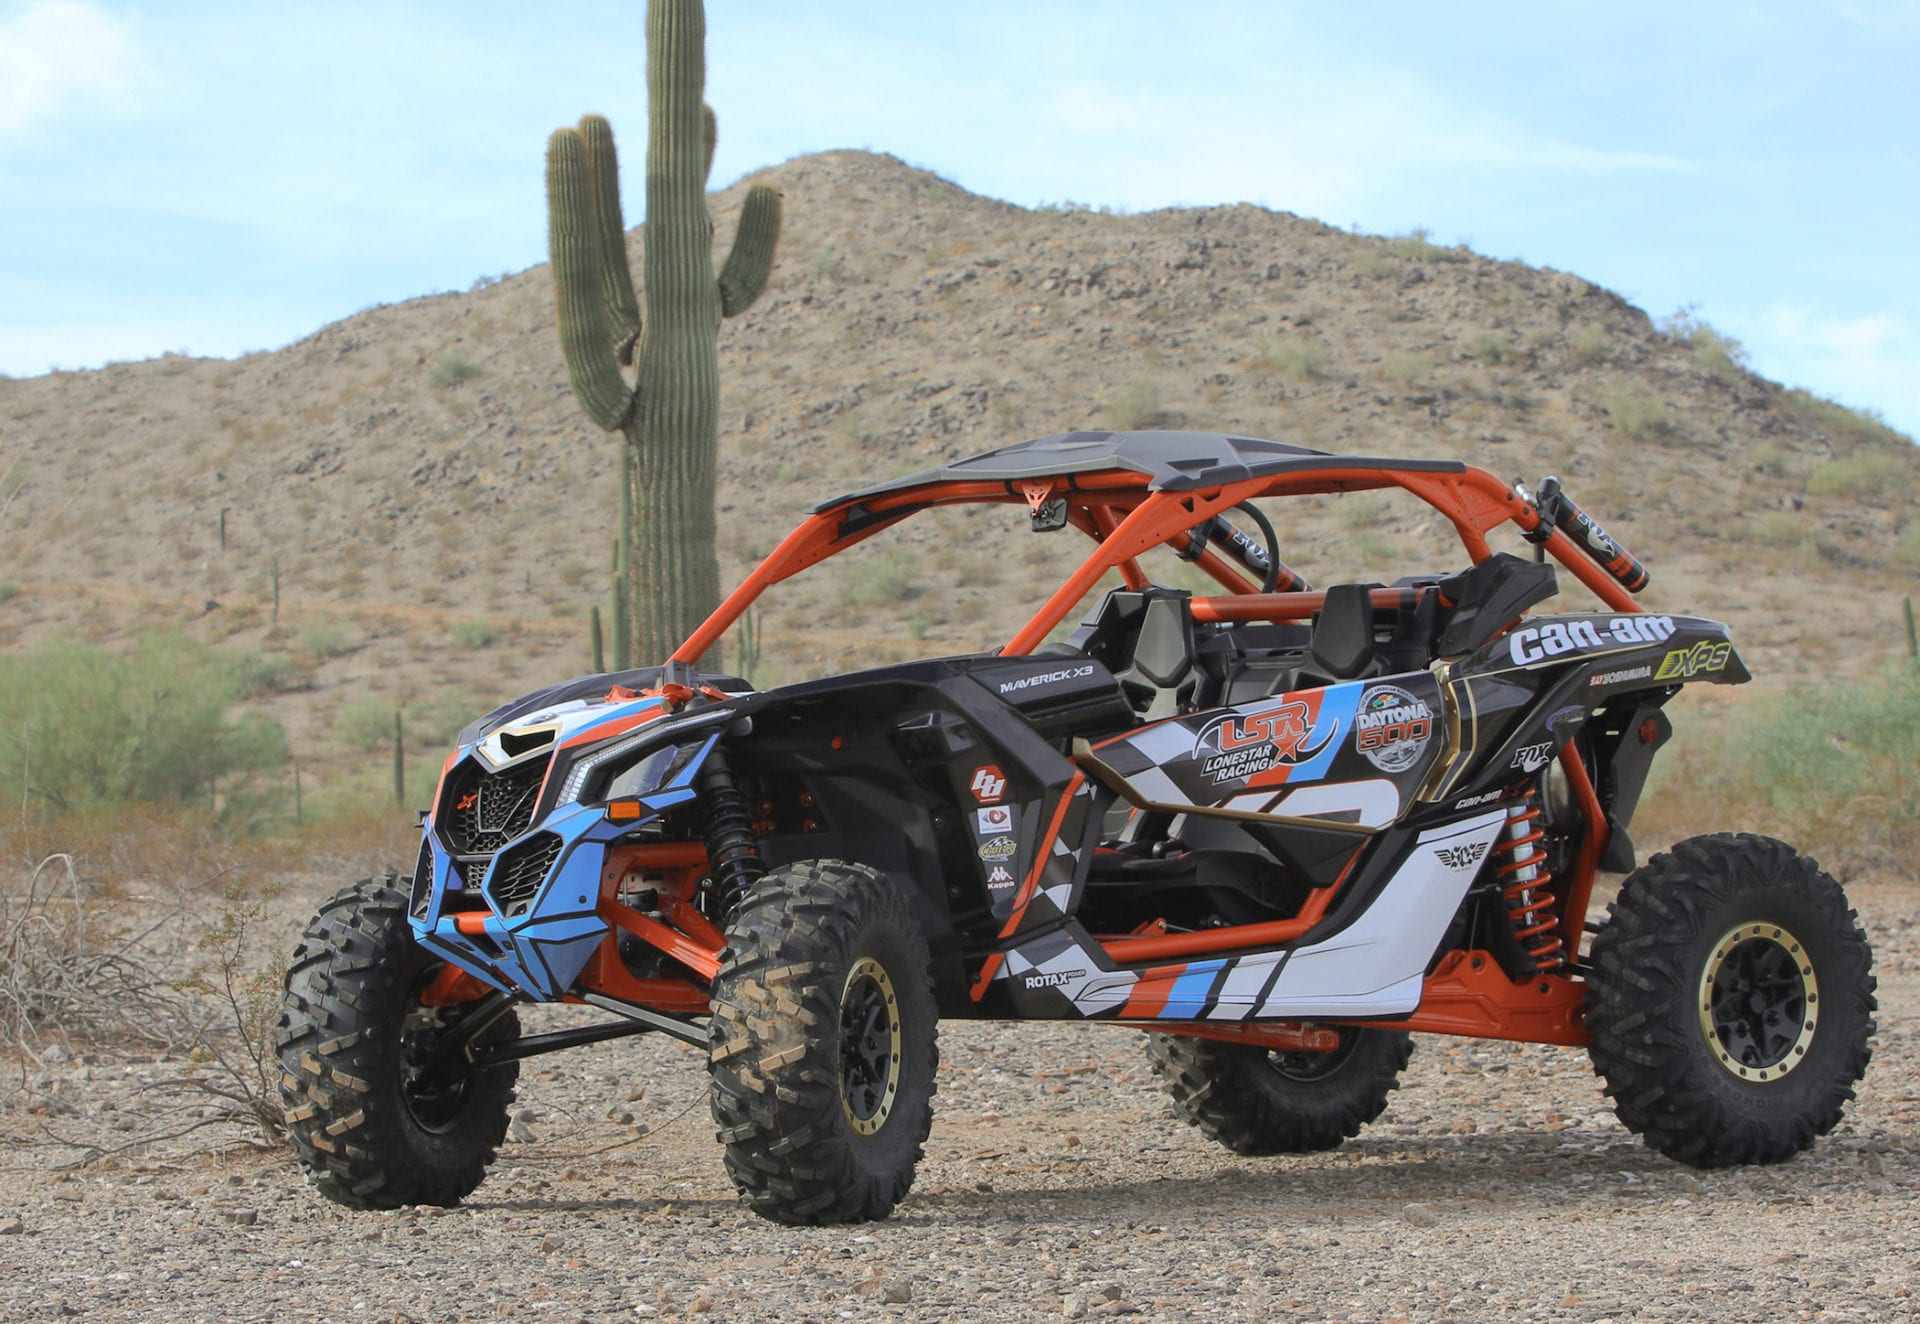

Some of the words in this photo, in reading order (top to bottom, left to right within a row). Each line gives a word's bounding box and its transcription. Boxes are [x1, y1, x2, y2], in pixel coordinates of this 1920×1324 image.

[1673, 640, 1732, 677] XPS
[1000, 671, 1071, 693] MAVERICK
[1073, 666, 1093, 678] X3
[1358, 703, 1428, 729] DAYTONA
[1359, 719, 1429, 751] 500
[1204, 745, 1272, 774] LONESTAR
[1510, 741, 1554, 773] FOX
[1216, 761, 1273, 781] RACING
[987, 881, 1015, 890] Kappa
[1025, 972, 1069, 989] ROTAX
